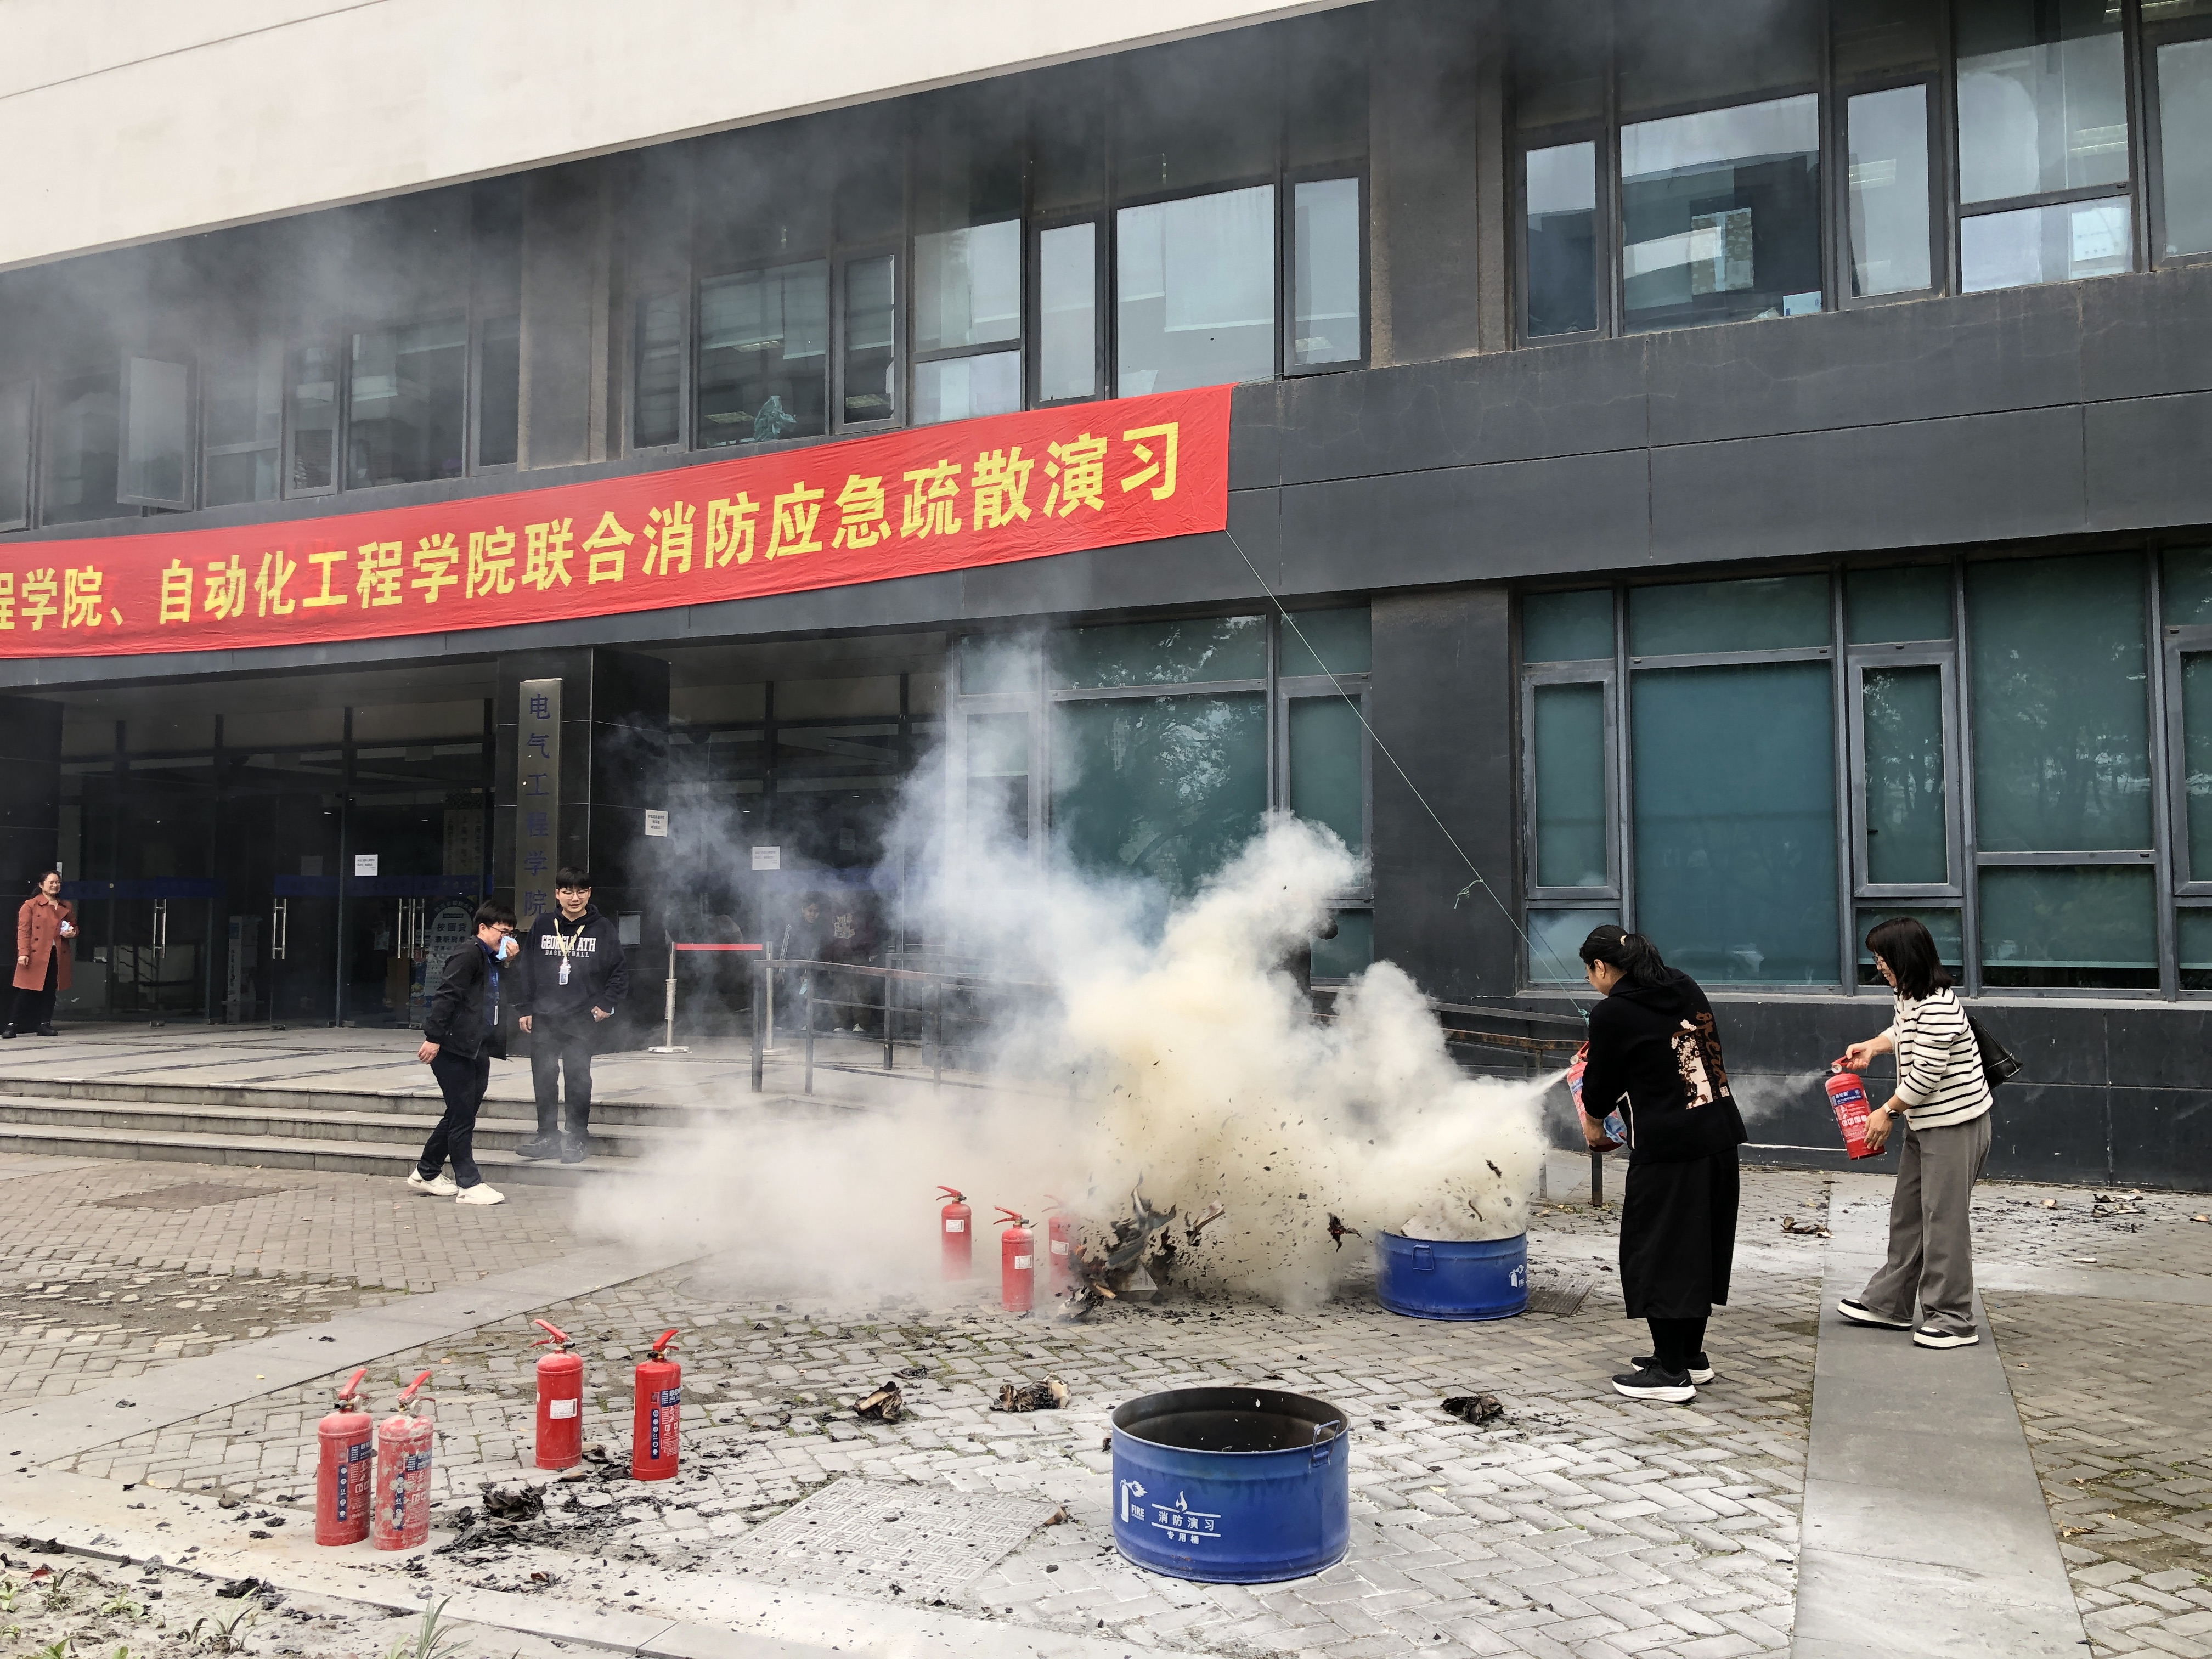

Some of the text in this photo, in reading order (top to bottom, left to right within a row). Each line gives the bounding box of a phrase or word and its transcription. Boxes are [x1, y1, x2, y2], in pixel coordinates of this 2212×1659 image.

[524, 693, 551, 917] 电气工程学院
[576, 937, 596, 952] ATH
[1131, 1504, 1145, 1518] FIRE
[1158, 1510, 1214, 1531] 消防演习
[1166, 1530, 1199, 1545] 专用桶
